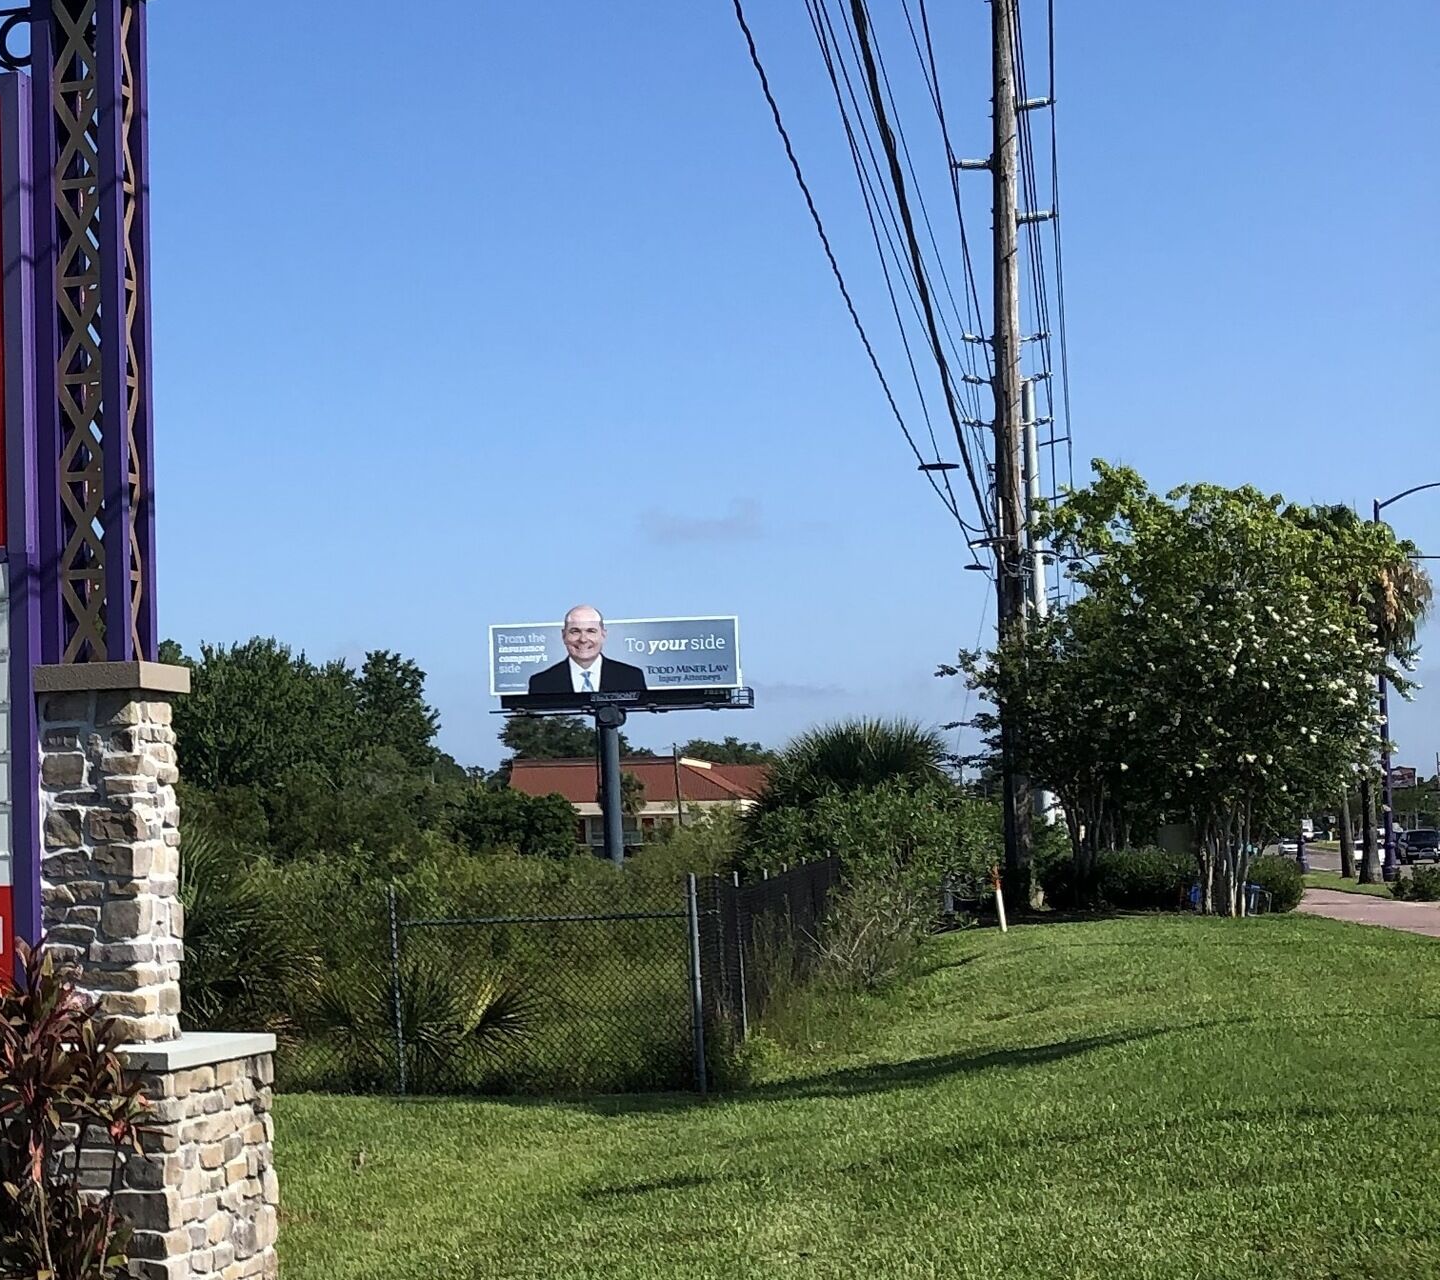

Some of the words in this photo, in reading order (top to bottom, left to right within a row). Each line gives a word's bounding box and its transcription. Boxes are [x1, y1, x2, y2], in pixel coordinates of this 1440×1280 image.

[497, 633, 527, 644] From
[528, 632, 546, 643] the
[624, 637, 645, 652] To
[648, 639, 688, 655] your
[690, 633, 726, 650] side
[498, 664, 521, 674] side
